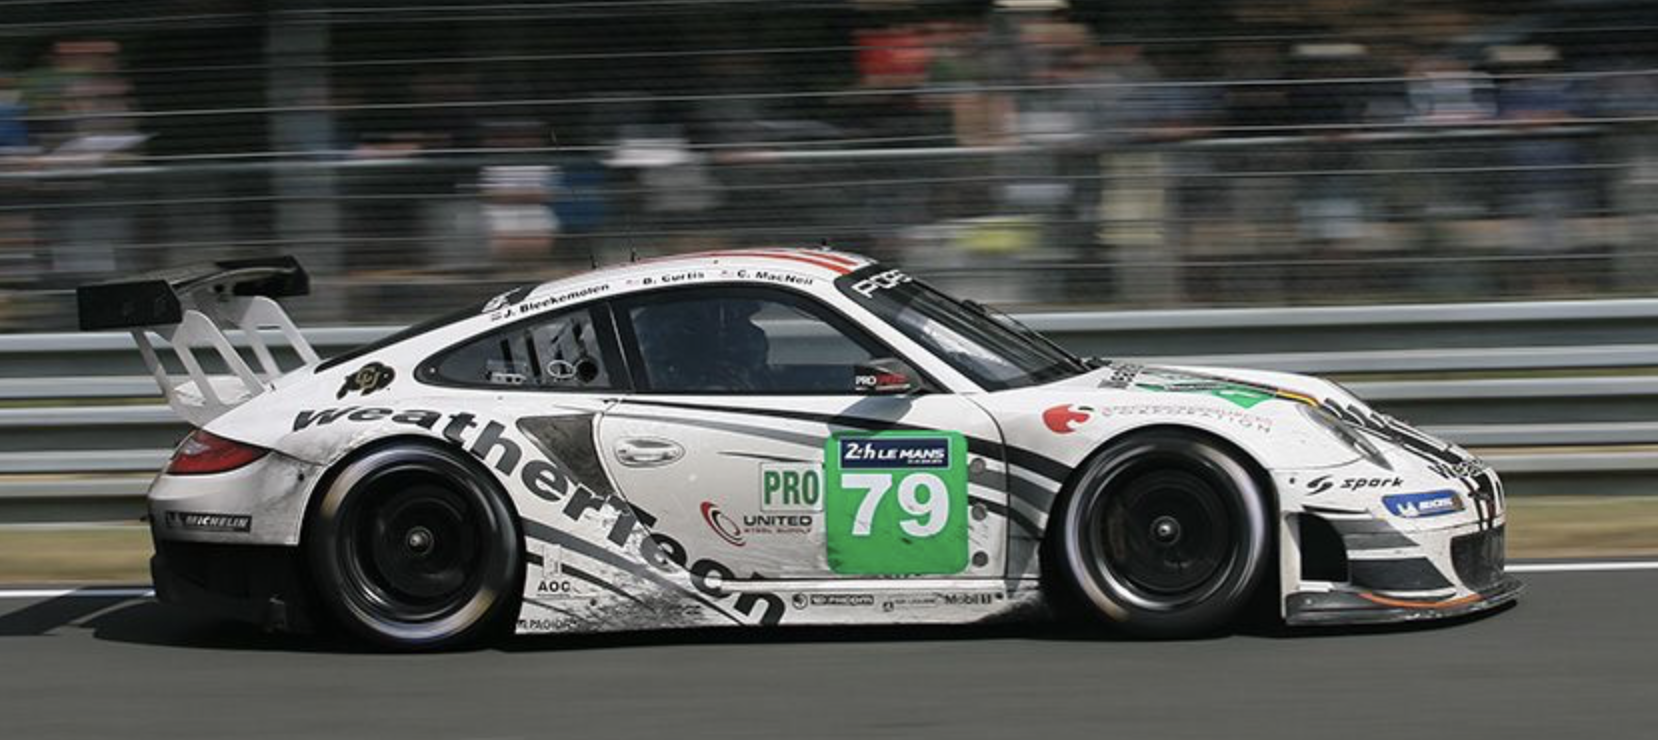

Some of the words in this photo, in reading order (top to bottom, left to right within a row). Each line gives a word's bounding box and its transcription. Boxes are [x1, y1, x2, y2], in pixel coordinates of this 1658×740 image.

[661, 271, 705, 282] Curtis
[878, 448, 898, 459] LE
[899, 448, 945, 459] MANS
[763, 470, 819, 506] PRO
[1340, 477, 1404, 491] spark
[841, 473, 950, 538] 79
[743, 515, 813, 526] UNITED
[538, 581, 571, 593] AOC
